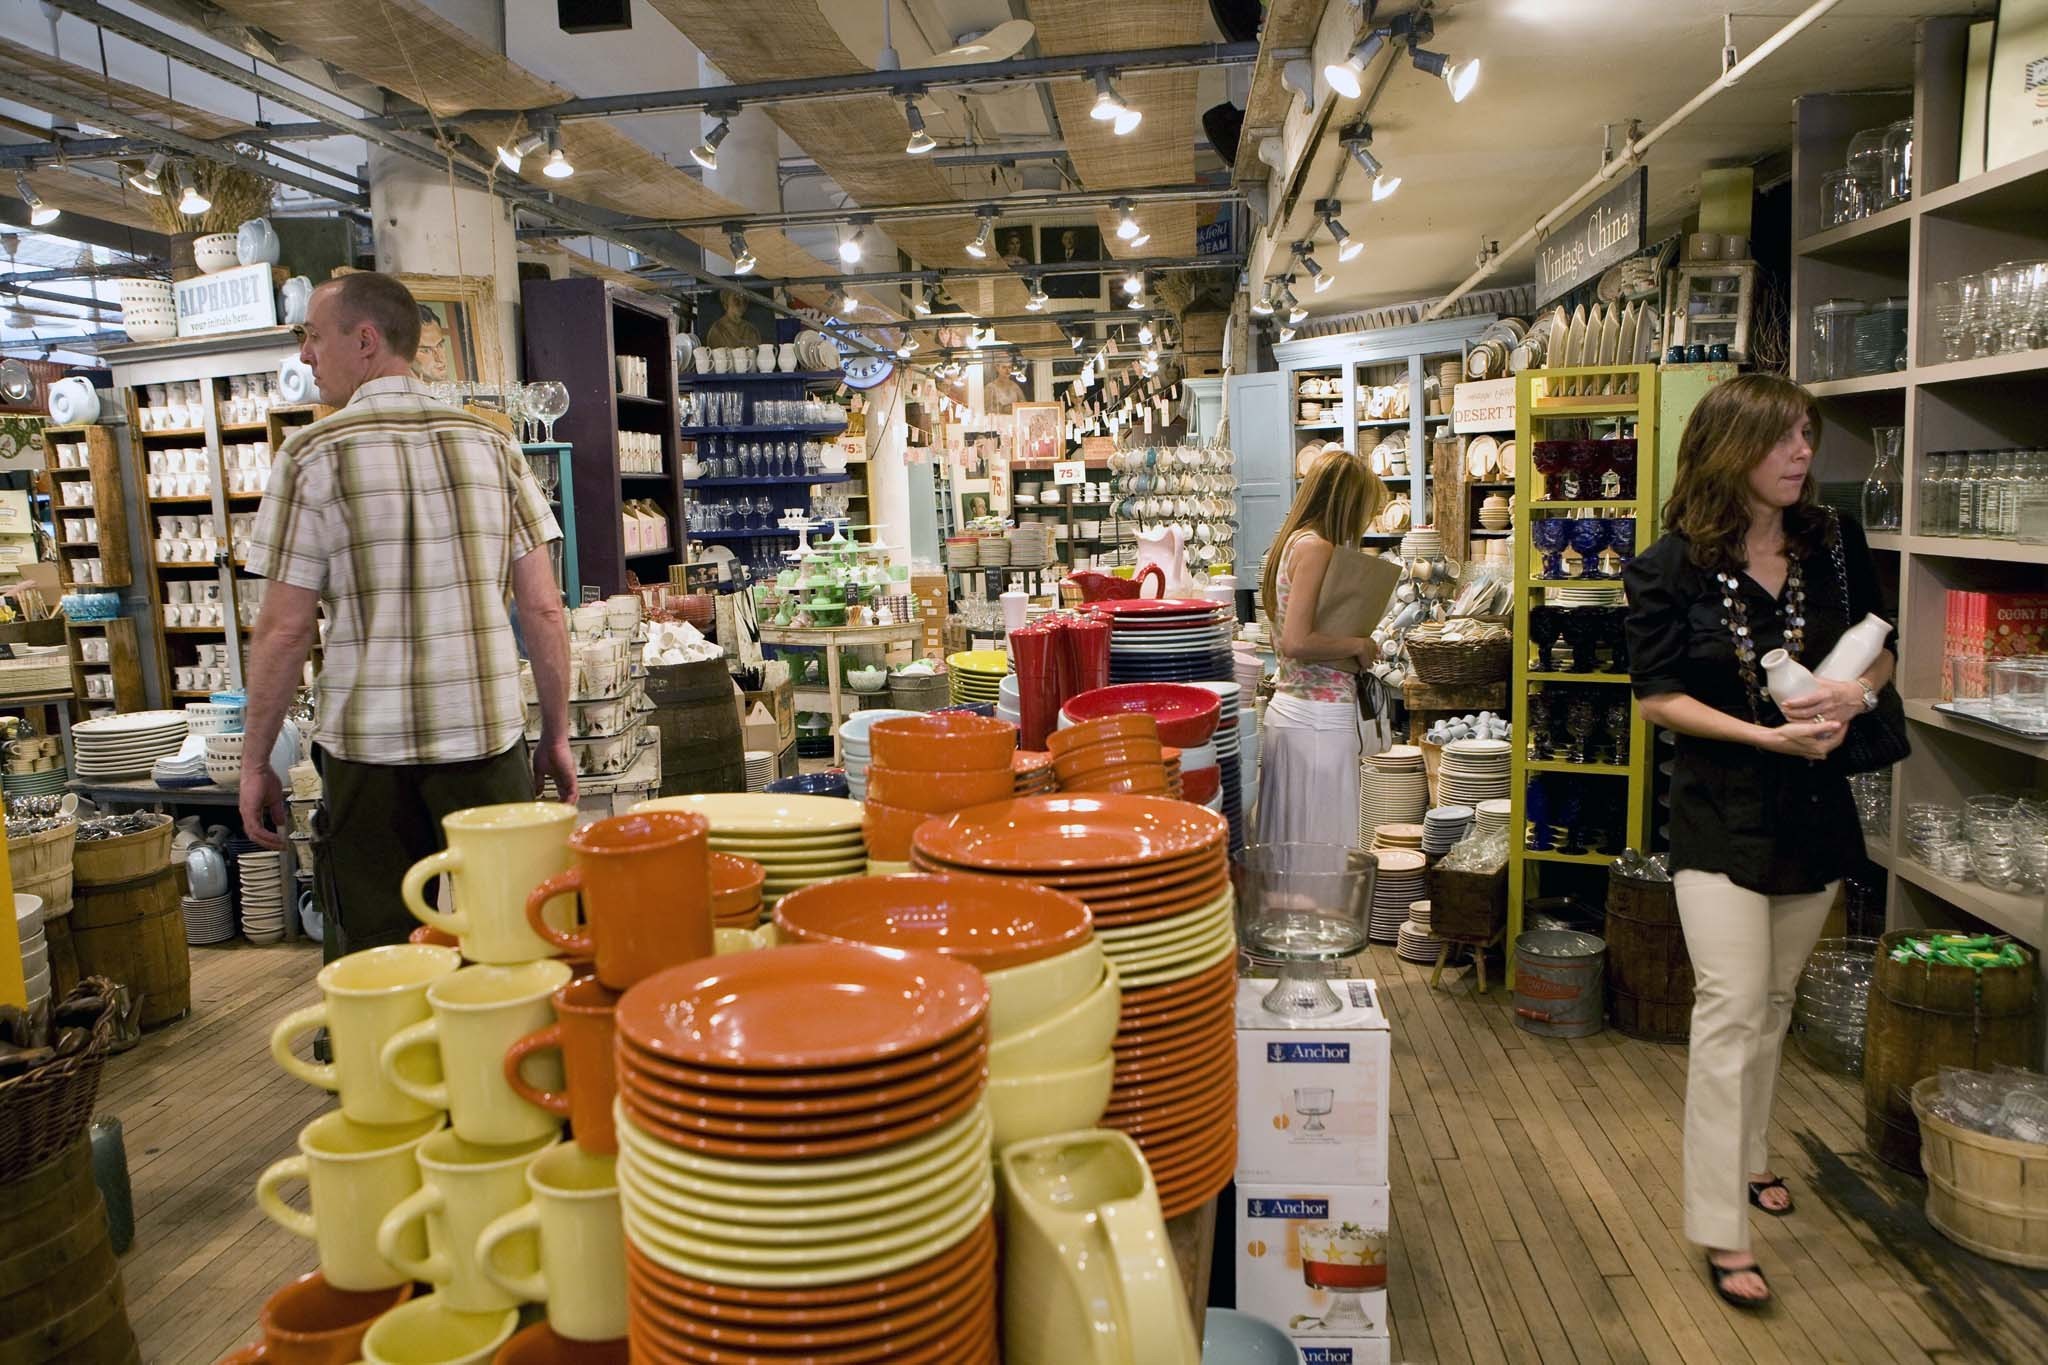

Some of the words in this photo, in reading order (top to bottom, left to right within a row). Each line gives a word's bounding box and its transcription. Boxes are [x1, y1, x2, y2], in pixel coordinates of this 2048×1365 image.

[1542, 241, 1584, 288] Vintage
[1587, 206, 1629, 257] China
[180, 275, 260, 318] ALPHABET
[191, 321, 207, 333] your
[208, 315, 231, 331] initials
[1455, 405, 1504, 423] DESERT
[1507, 404, 1516, 418] T
[2040, 608, 2048, 620] B
[1291, 1044, 1348, 1059] Anchor
[1271, 1200, 1327, 1216] Anchor
